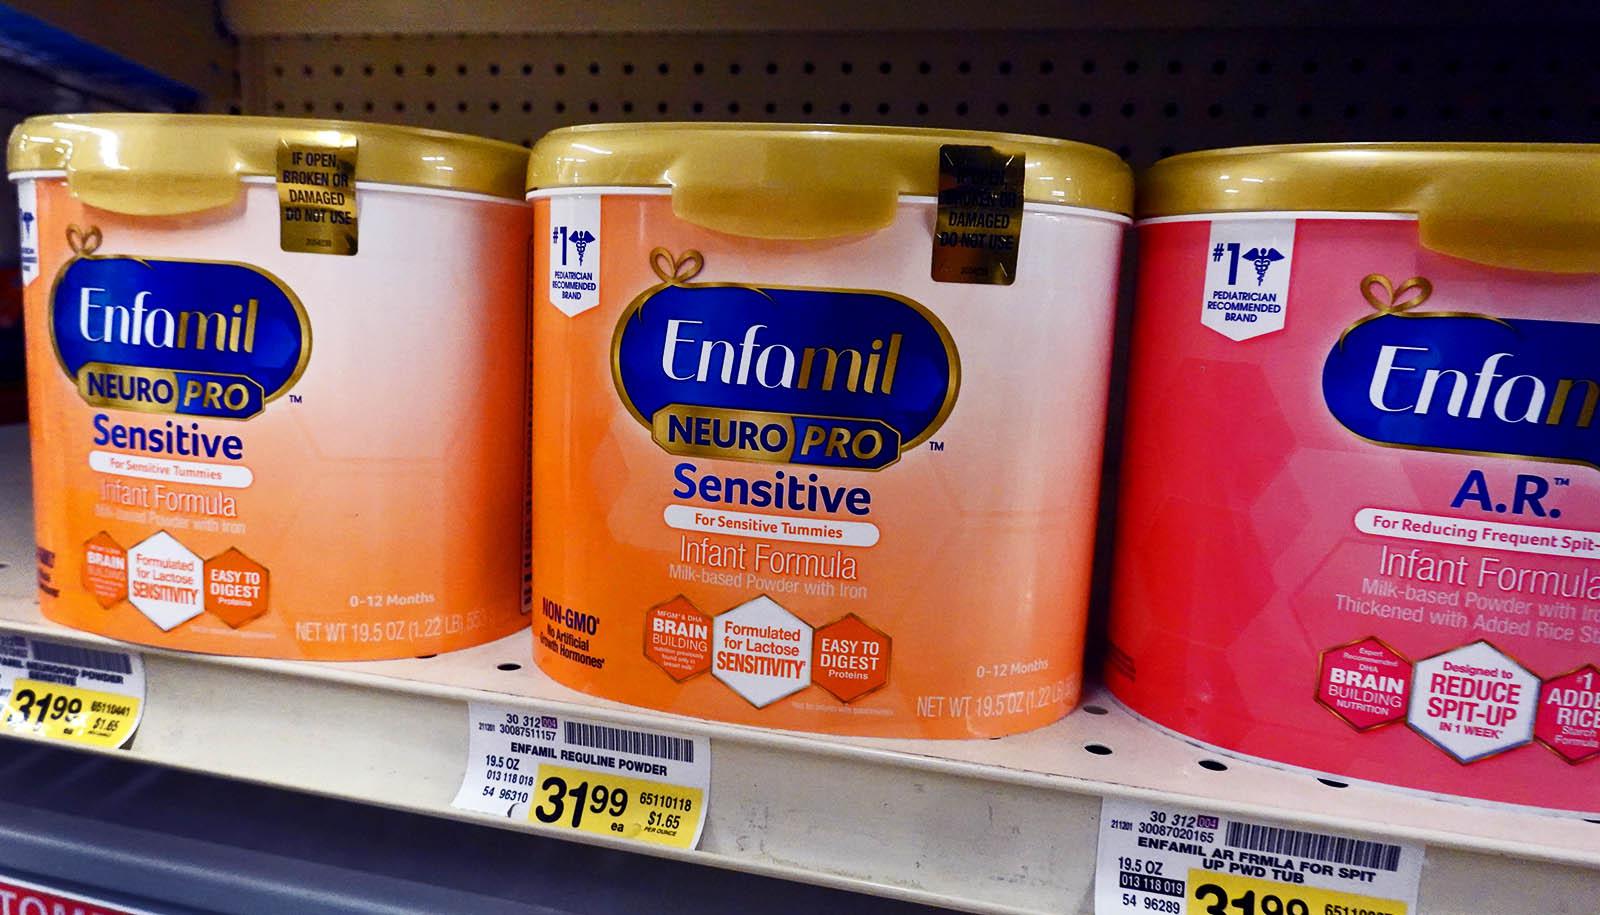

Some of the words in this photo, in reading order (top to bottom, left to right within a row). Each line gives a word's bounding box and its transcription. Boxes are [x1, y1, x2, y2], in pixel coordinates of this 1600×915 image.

[291, 151, 303, 165] IF
[305, 152, 340, 170] OPEN,
[282, 170, 329, 186] BROKEN
[333, 173, 349, 188] OR
[289, 189, 345, 206] DAMAGED
[285, 207, 302, 221] DO
[305, 208, 326, 223] NOT
[330, 210, 352, 225] USE
[948, 211, 1010, 229] DAMAGED
[552, 226, 568, 266] #1
[940, 231, 958, 247] DO
[960, 232, 986, 249] NOT
[989, 234, 1015, 251] USE
[1212, 242, 1241, 286] #1
[552, 280, 597, 291] RECOMMENDED
[554, 271, 593, 281] PEDIATRICIAN
[561, 291, 582, 301] BRAND
[1212, 290, 1277, 303] PEDIATRICIAN
[1207, 300, 1282, 314] RECOMMENDED
[79, 287, 259, 353] Enfamil
[1224, 312, 1258, 323] BRAND
[661, 318, 903, 395] Enfamil
[93, 413, 243, 461] Sensitive
[110, 457, 123, 469] For
[126, 459, 171, 475] Sensitive
[173, 465, 223, 481] Tummies
[103, 478, 150, 508] Infant
[154, 484, 238, 518] Formula
[672, 462, 872, 516] Sensitive
[695, 513, 716, 527] For
[717, 515, 778, 534] Sensitive
[781, 521, 843, 539] Tummies
[1373, 515, 1399, 529] For
[1402, 518, 1478, 542] Reducing
[1481, 527, 1559, 547] Frequent
[86, 551, 125, 570] BRAIN
[136, 552, 195, 572] Formulated
[680, 535, 747, 570] Infant
[755, 543, 857, 580] Formula
[136, 568, 150, 579] for
[153, 571, 195, 586] Lactose
[210, 568, 242, 583] EASY
[244, 572, 261, 585] TO
[668, 563, 743, 588] Milk-based
[746, 574, 800, 594] Powder
[804, 580, 837, 597] with
[840, 583, 868, 599] Iron
[1379, 545, 1470, 586] Infant
[1477, 556, 1600, 601] Formula
[210, 582, 261, 599] DIGEST
[349, 594, 383, 608] 0-12
[386, 591, 436, 606] Months
[1361, 577, 1460, 607] Milk-based
[1465, 592, 1533, 616] Powder
[1538, 601, 1577, 620] with
[1335, 593, 1424, 624] Thickened
[1428, 610, 1468, 629] with
[1472, 615, 1531, 637] Added
[1536, 621, 1575, 642] Rice
[296, 621, 322, 641] NET
[324, 622, 347, 642] WT
[352, 622, 382, 642] 19.5
[386, 620, 405, 641] OZ
[547, 623, 555, 639] No
[556, 628, 589, 652] Artificial
[652, 617, 708, 640] BRAIN
[724, 621, 801, 642] Formulated
[652, 632, 708, 652] BUILDING
[724, 636, 743, 650] for
[746, 638, 800, 657] Lactose
[821, 638, 858, 655] EASY
[861, 641, 880, 656] TO
[1359, 647, 1384, 657] Expert
[820, 654, 880, 671] DIGEST
[976, 664, 1008, 679] 0-12
[1010, 659, 1049, 675] Months
[1358, 663, 1379, 673] DHA
[1443, 660, 1499, 678] Designed
[1501, 668, 1514, 680] to
[81, 669, 124, 685] POWDER
[828, 669, 869, 681] Proteins
[1329, 667, 1405, 695] BRAIN
[1328, 684, 1403, 708] BUILDING
[1430, 672, 1522, 706] REDUCE
[1546, 687, 1600, 711] ADDE
[916, 696, 945, 718] NET
[949, 696, 972, 718] WT
[976, 694, 1006, 717] 19.5
[1007, 691, 1025, 714] OZ
[1336, 699, 1390, 716] NUTRITION
[1426, 696, 1518, 728] SPIT-UP
[92, 717, 120, 732] $1.65
[506, 713, 519, 725] 30
[523, 715, 541, 729] 312
[1438, 721, 1452, 732] IN
[1455, 724, 1462, 734] 1
[1556, 707, 1600, 729] RICE
[499, 723, 557, 741] 30087511157
[1562, 725, 1598, 738] Starch
[486, 754, 505, 768] 19.5
[506, 757, 520, 771] OZ
[510, 741, 557, 759] ENFAMIL
[560, 751, 615, 768] REGULINE
[618, 760, 668, 777] POWDER
[486, 769, 501, 781] 013
[504, 772, 517, 784] 118
[519, 774, 534, 787] 018
[482, 786, 495, 797] 54
[499, 788, 529, 803] 96310
[640, 791, 692, 812] 65110118
[611, 822, 624, 833] ea
[647, 810, 681, 829] $1.65
[1150, 810, 1167, 823] 30
[1171, 813, 1197, 828] 312
[656, 828, 677, 837] OUNCE
[1138, 821, 1214, 844] 30087020165
[1118, 855, 1142, 873] 19.5
[1145, 860, 1164, 876] OZ
[1137, 836, 1206, 857] ENFAMIL
[1211, 848, 1234, 861] AR
[1238, 852, 1295, 871] FRMLA
[1299, 861, 1334, 877] FOR
[1338, 866, 1377, 883] SPIT
[1202, 858, 1225, 871] UP
[1229, 862, 1267, 878] PWD
[1271, 868, 1305, 884] TUB
[1121, 873, 1140, 888] 013
[1143, 877, 1162, 892] 118
[1164, 880, 1183, 895] 019
[1122, 893, 1137, 907] 54
[1143, 896, 1181, 915] 96289
